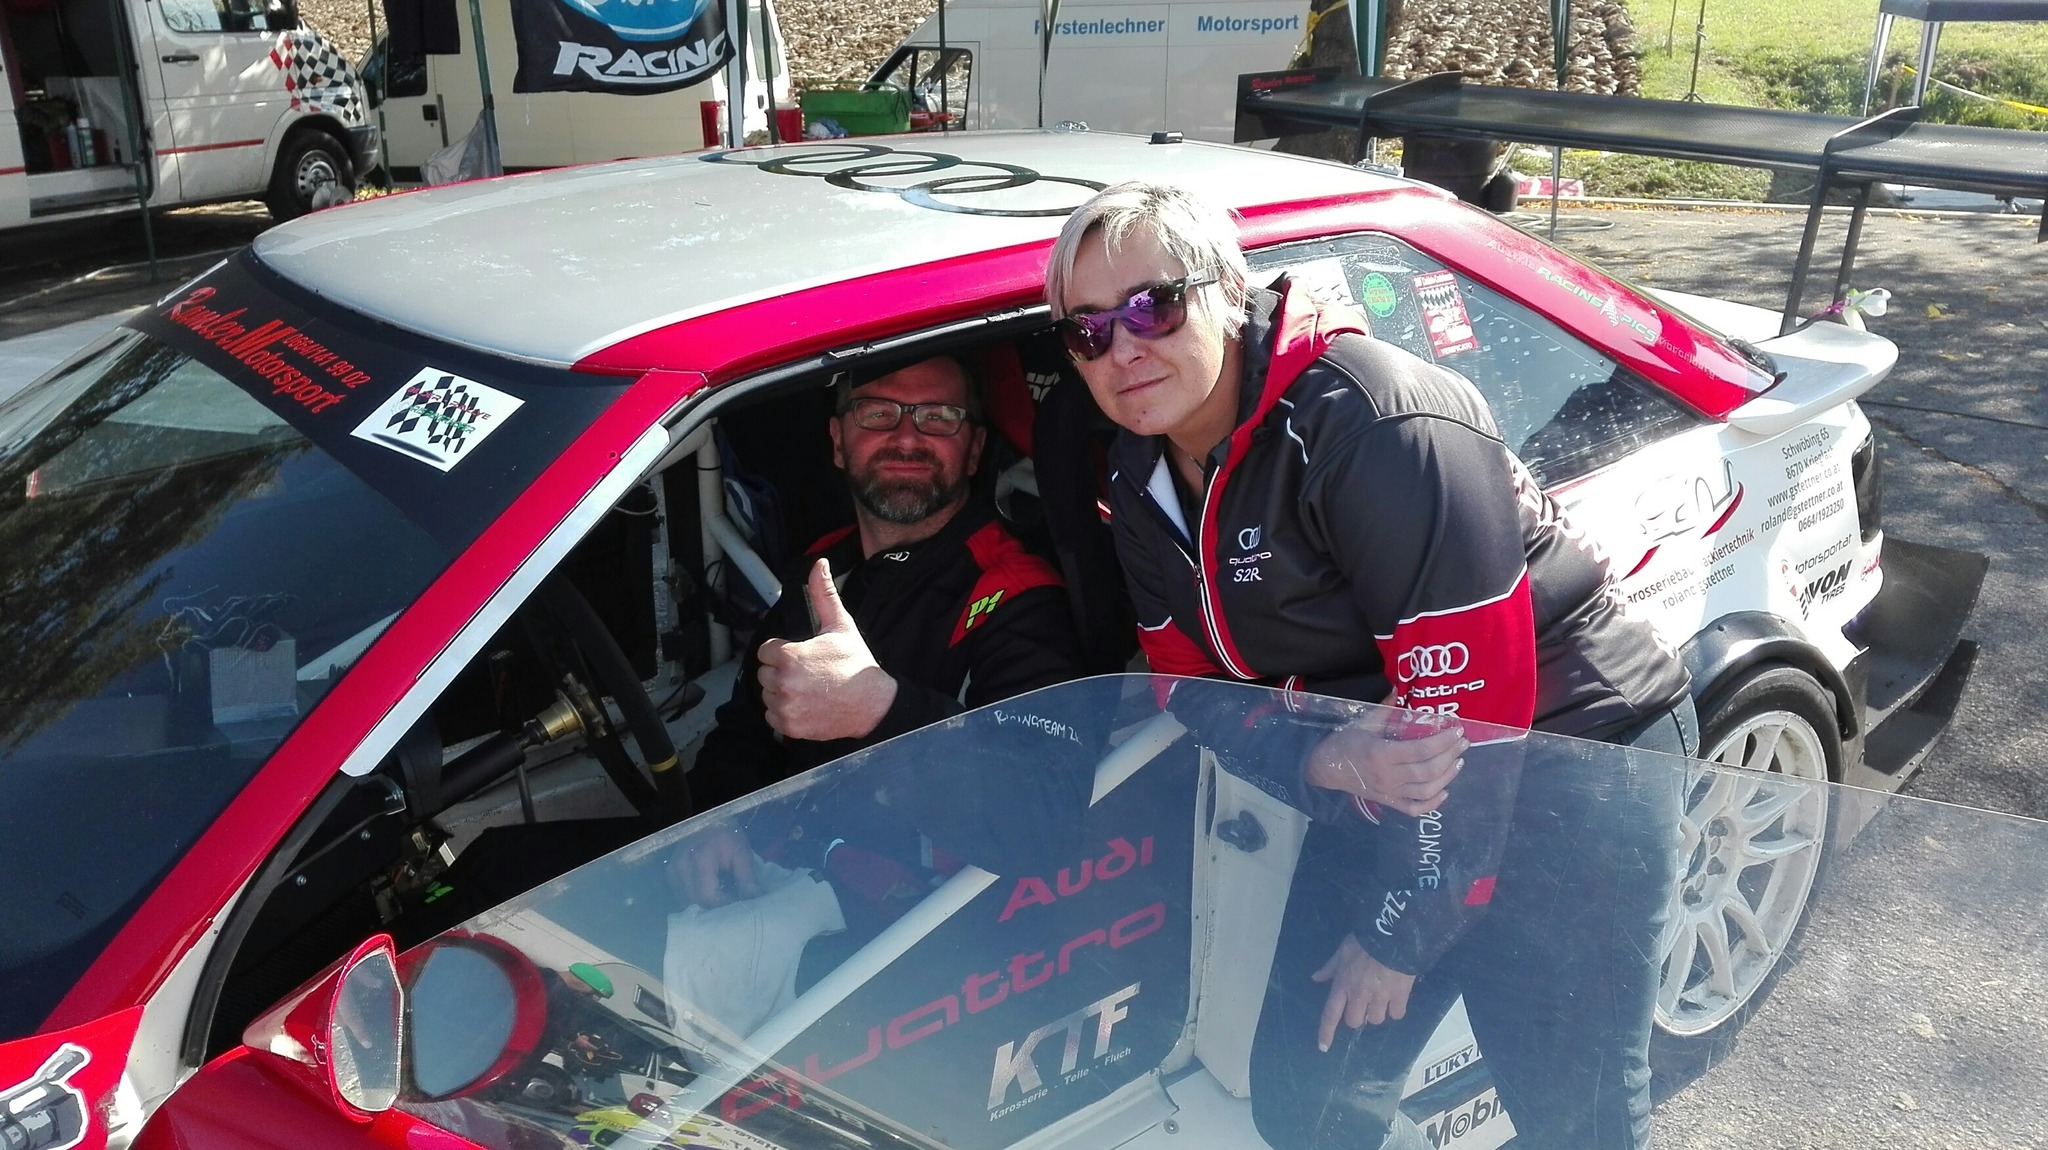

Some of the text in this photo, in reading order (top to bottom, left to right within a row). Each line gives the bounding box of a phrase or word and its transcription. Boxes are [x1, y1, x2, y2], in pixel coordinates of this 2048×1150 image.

[1033, 14, 1299, 35] Frstenlechner Motorsport
[1620, 313, 1659, 346] PICS
[325, 359, 355, 377] 99
[341, 371, 371, 388] 02
[1782, 427, 1830, 460] Schwöbing 65
[1785, 461, 1804, 480] 8670
[1760, 481, 1844, 533] roland@gstettner.co.at
[1798, 498, 1845, 532] 0664/1923250
[1794, 533, 1853, 575] otorsport.at
[1233, 566, 1263, 582] S2R
[1820, 582, 1846, 604] TYRES
[997, 836, 1154, 923] Audi
[719, 903, 1166, 1122] quattro
[987, 981, 1141, 1110] KTF
[990, 1047, 1131, 1122] Karosserie Teile Fluch
